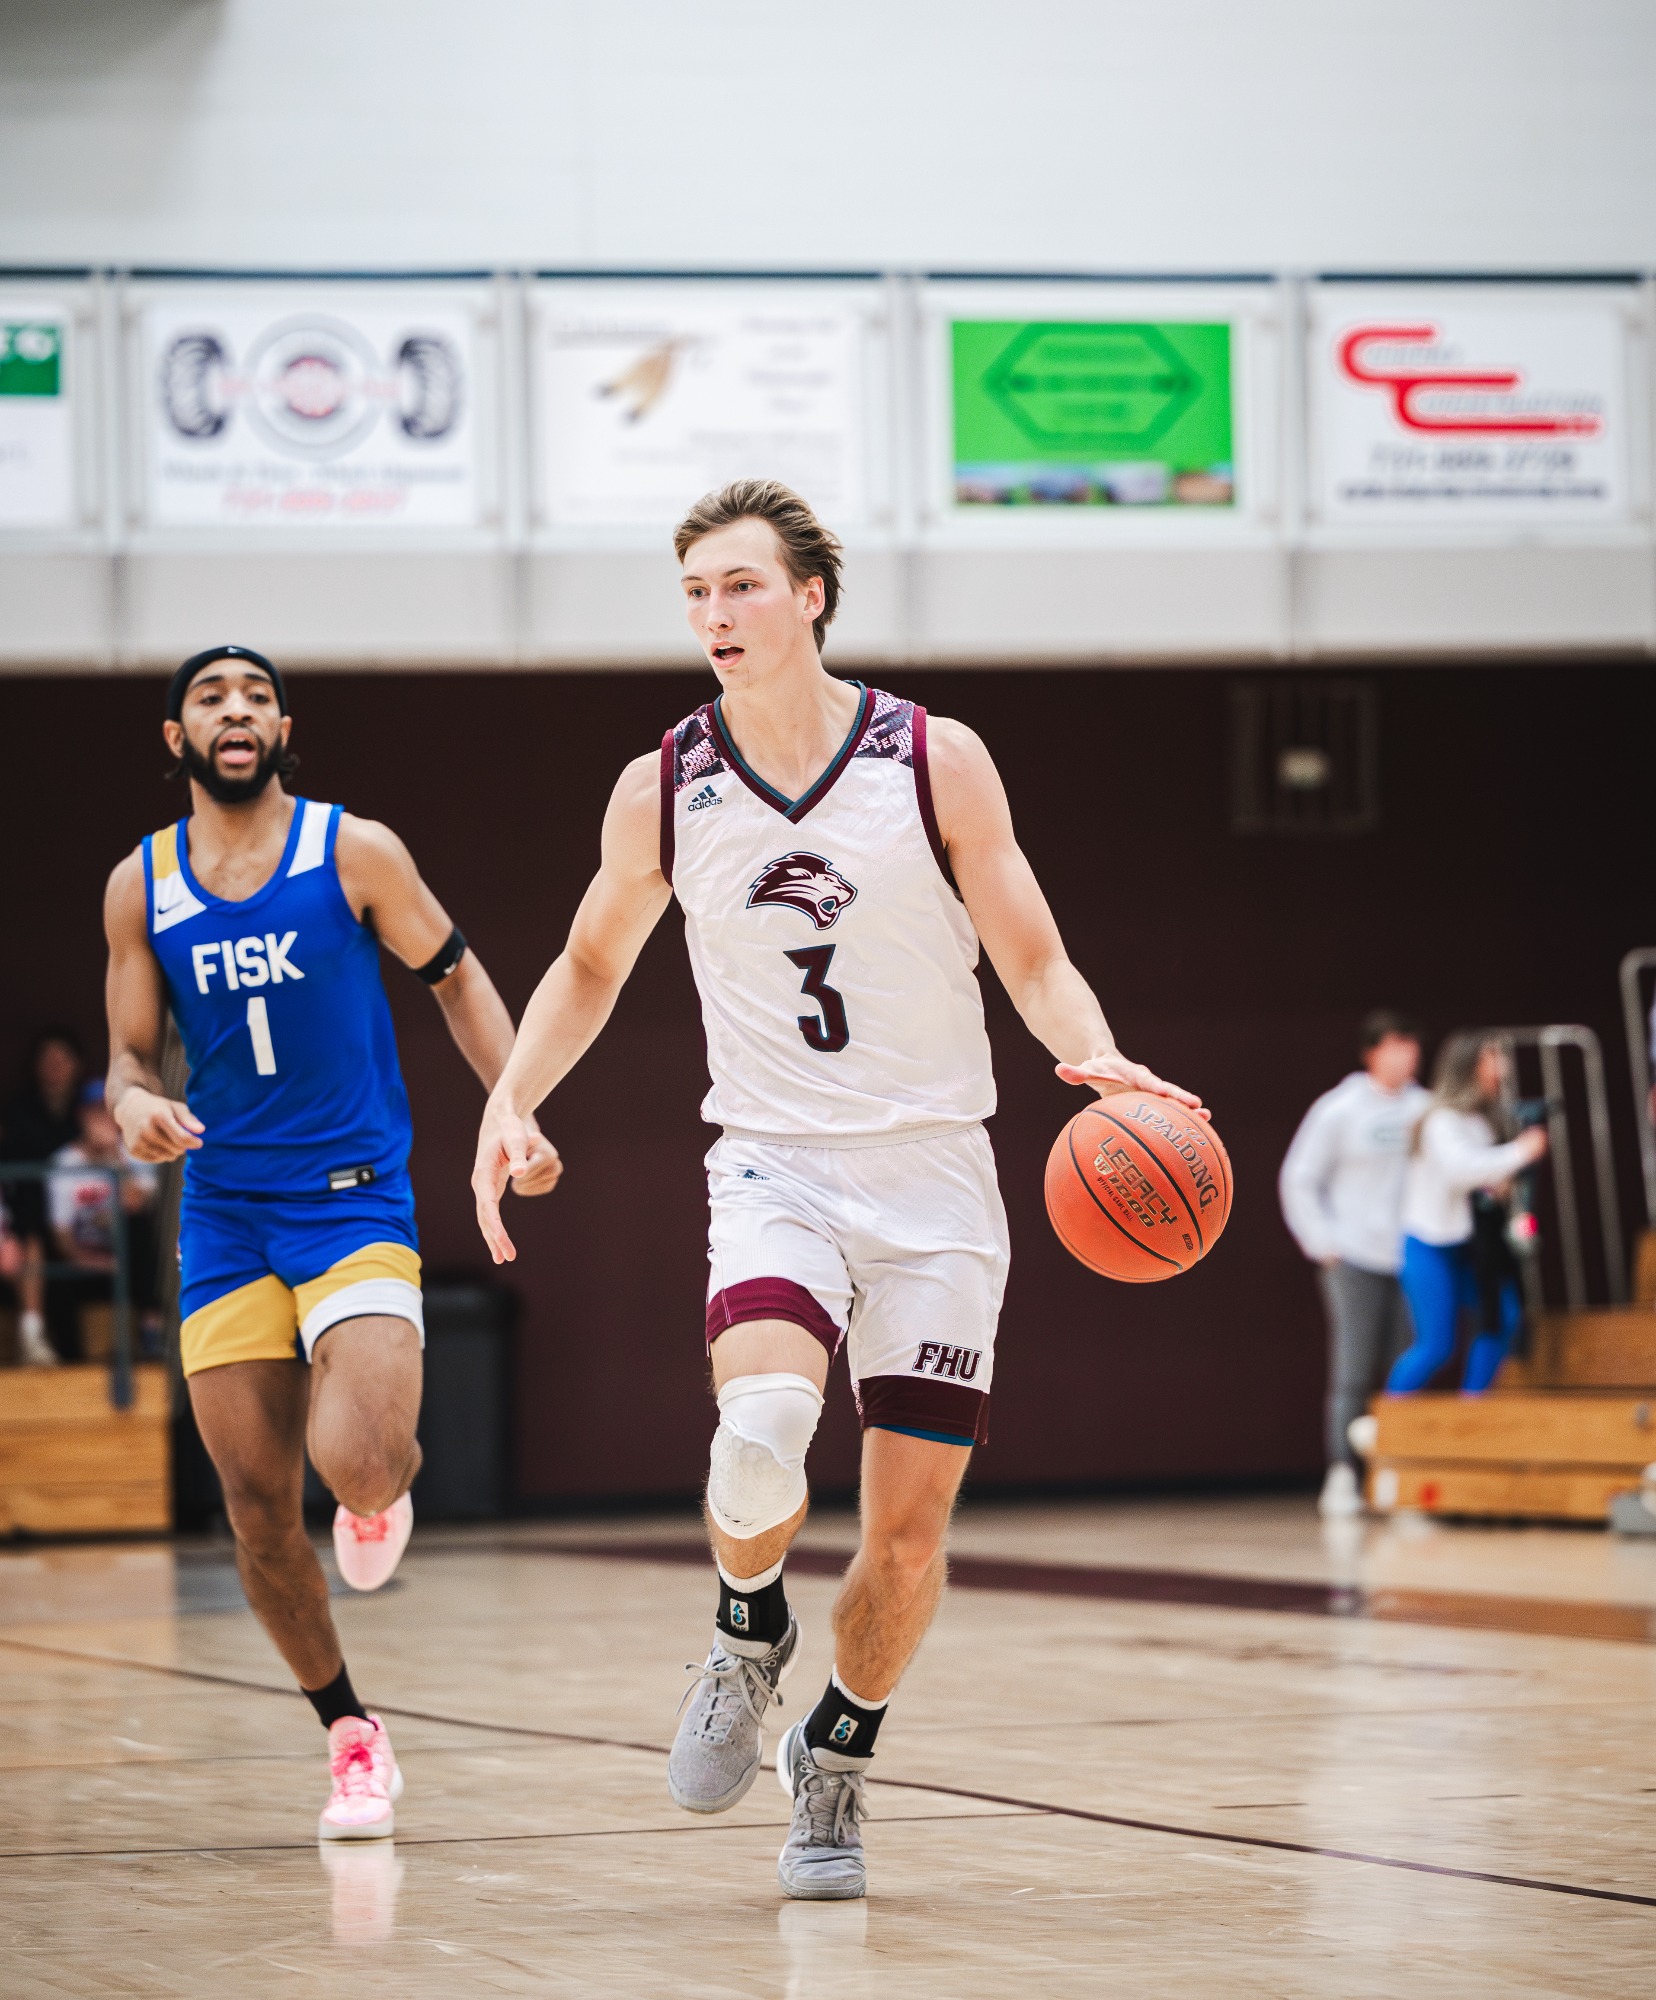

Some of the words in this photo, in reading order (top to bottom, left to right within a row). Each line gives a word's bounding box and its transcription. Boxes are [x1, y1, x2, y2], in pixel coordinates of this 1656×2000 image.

[688, 796, 723, 811] adidas
[191, 930, 305, 994] FISK
[783, 944, 849, 1052] 3
[247, 996, 277, 1076] 1
[1097, 1135, 1178, 1226] LEGACY
[1097, 1176, 1115, 1198] OFFICIAL
[1125, 1103, 1219, 1210] SPALDING
[911, 1340, 982, 1382] FHU
